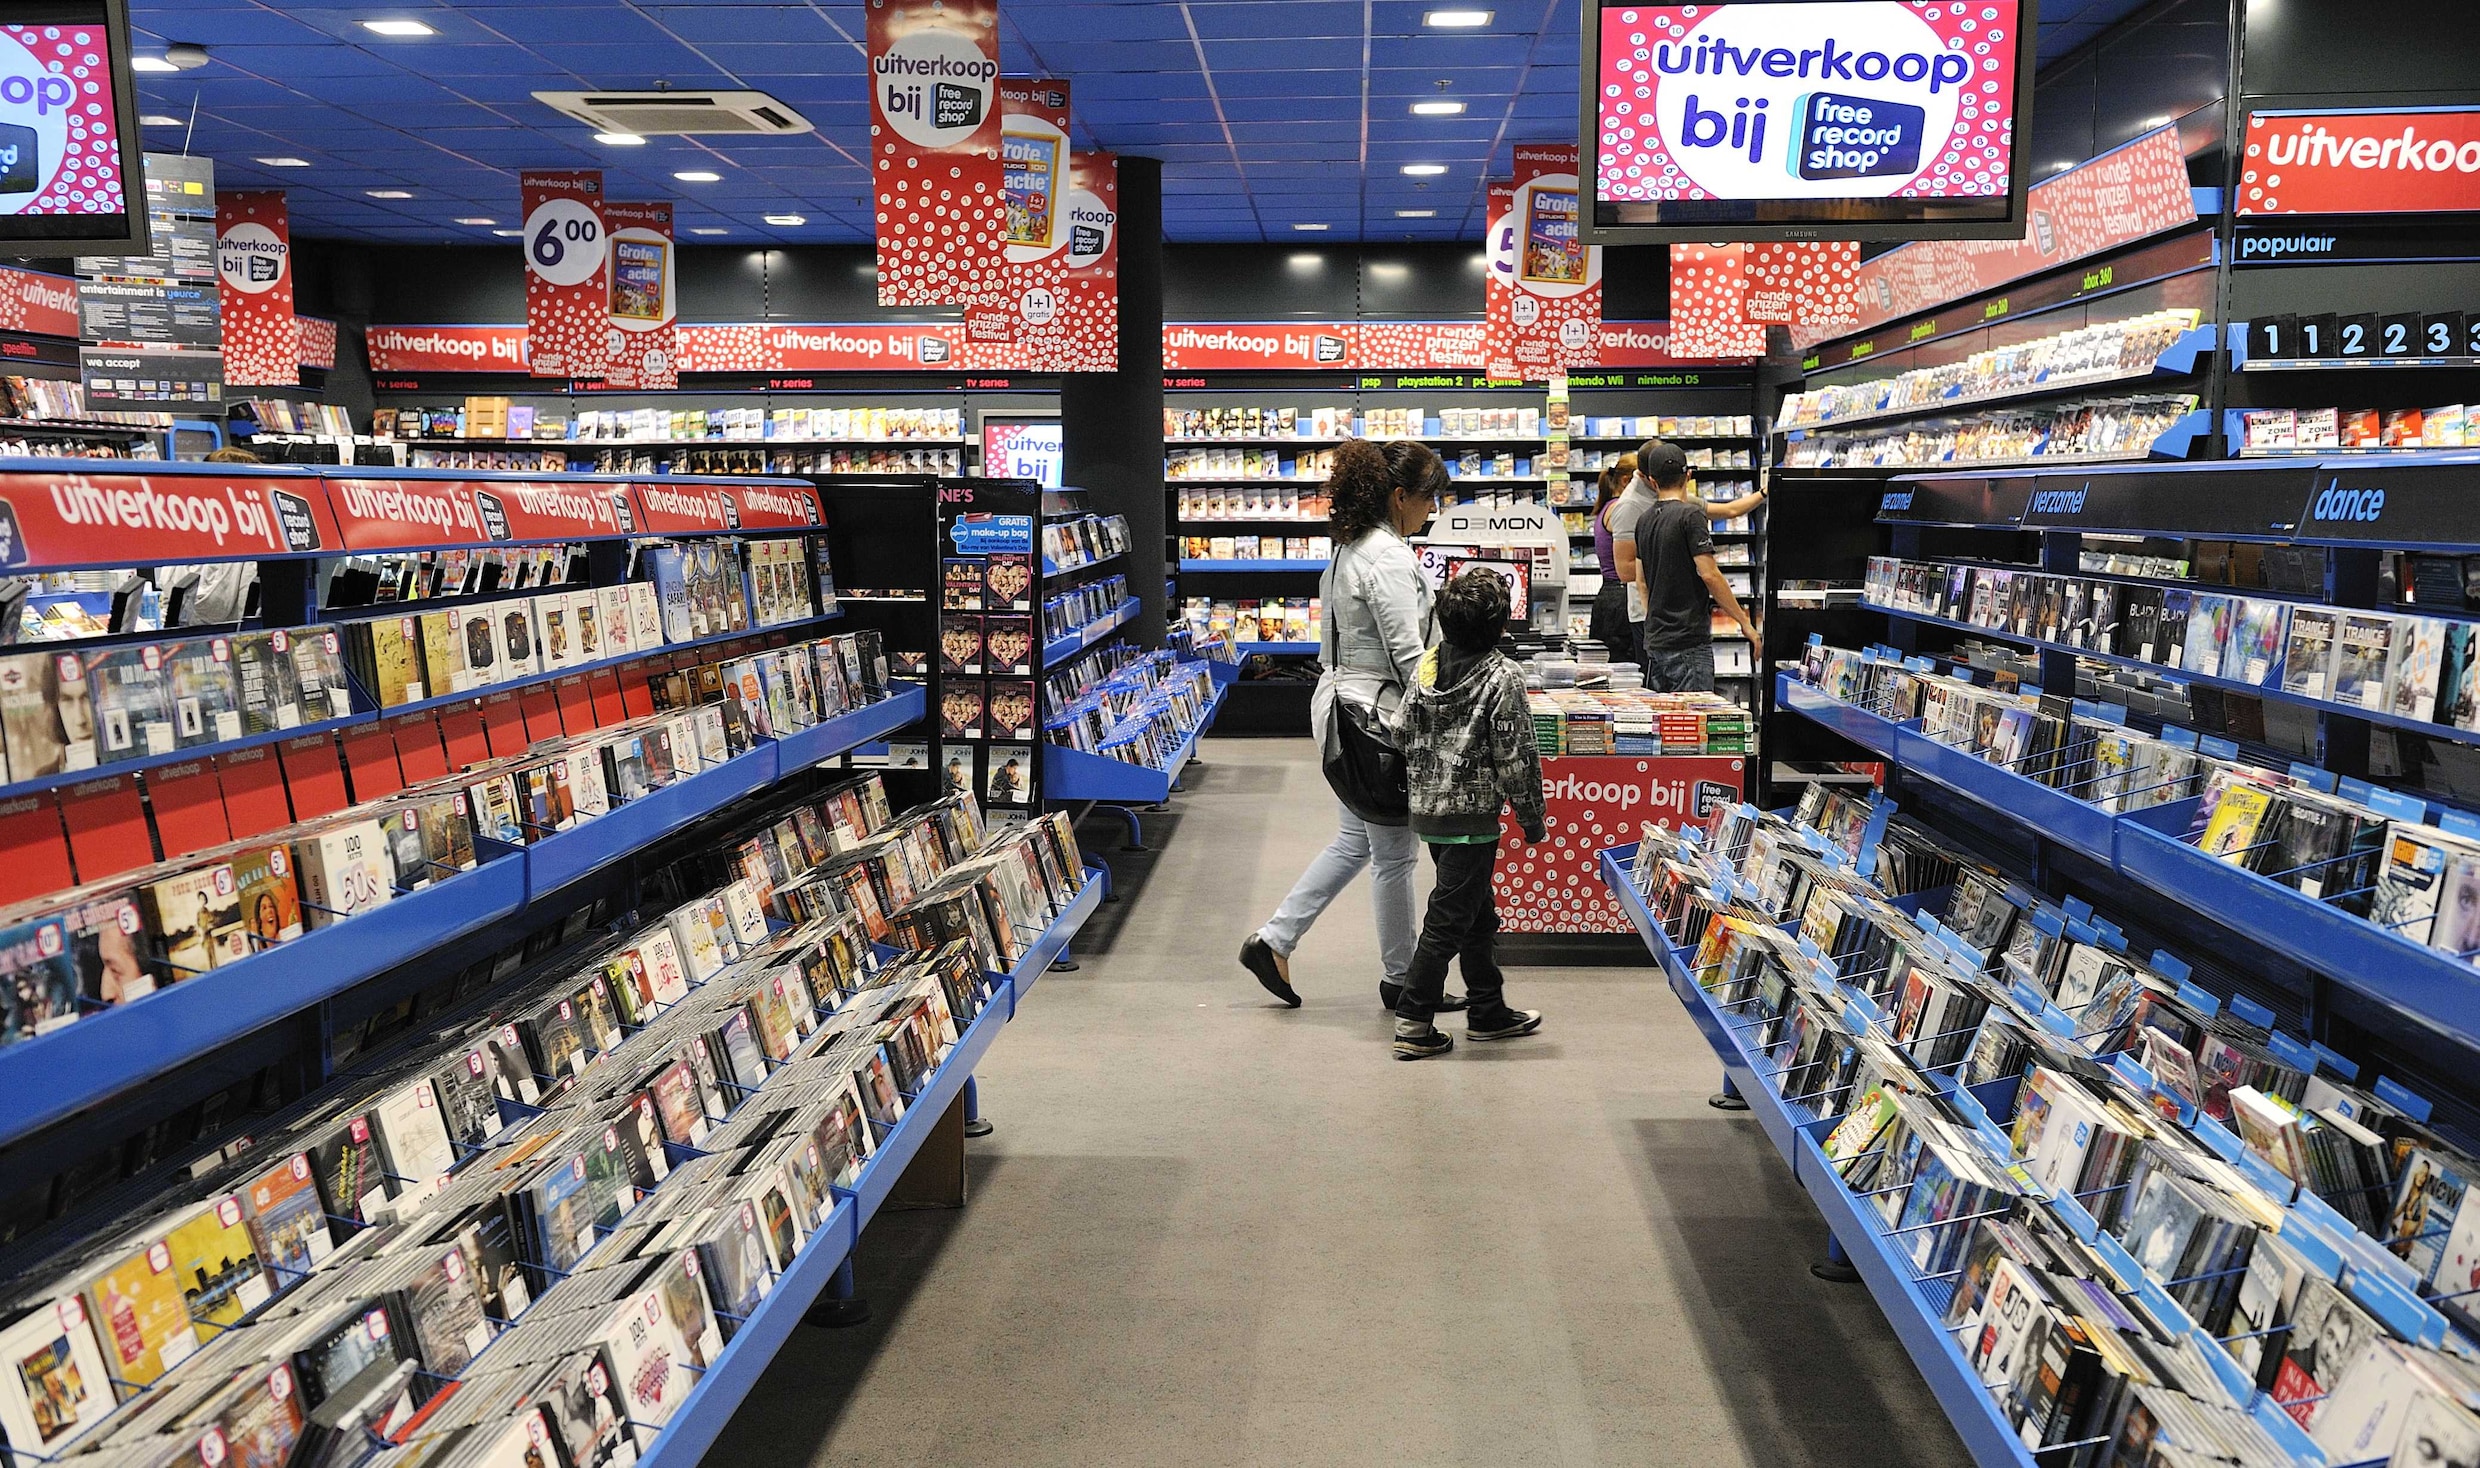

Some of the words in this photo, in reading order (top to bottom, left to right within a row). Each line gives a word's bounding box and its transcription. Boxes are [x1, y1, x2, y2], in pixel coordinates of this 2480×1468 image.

[876, 54, 996, 82] uitverkoop
[1658, 35, 1968, 93] uitverkoop
[939, 86, 961, 99] free
[888, 86, 920, 120] bij
[938, 98, 972, 111] record
[1814, 97, 1872, 125] free
[938, 110, 965, 124] shop
[1682, 95, 1769, 163] bij
[1811, 124, 1901, 147] record
[1808, 146, 1879, 173] shop
[2096, 155, 2132, 185] ronde
[524, 177, 570, 190] uitverkoop
[573, 179, 583, 191] bij
[1004, 173, 1045, 190] actie
[1030, 195, 1044, 204] 1+1
[1535, 193, 1578, 212] Grote
[2094, 184, 2132, 215] prijzen
[646, 210, 656, 221] bij
[2102, 204, 2143, 235] festival
[1075, 227, 1091, 236] free
[1545, 223, 1578, 237] actie
[216, 236, 287, 255] uitverkoop
[1075, 236, 1099, 245] record
[1075, 244, 1093, 253] shop
[2242, 232, 2336, 257] populair
[618, 243, 653, 260] Grote
[223, 258, 243, 276] bij
[252, 257, 266, 265] free
[252, 264, 274, 273] record
[252, 271, 271, 281] shop
[627, 268, 658, 281] actie
[80, 284, 154, 297] entertainment
[156, 286, 165, 297] is
[167, 290, 201, 300] yource
[1027, 295, 1050, 309] 1+1
[1746, 299, 1788, 312] prijzen
[976, 310, 1009, 323] ronde
[1027, 310, 1050, 320] gratis
[968, 319, 1004, 333] prijzen
[1437, 326, 1486, 339] ronde
[971, 328, 1009, 341] festival
[1565, 337, 1584, 345] gratis
[2264, 325, 2278, 353] 1
[2304, 325, 2318, 353] 1
[2342, 324, 2365, 354] 2
[2384, 323, 2407, 354] 2
[2427, 323, 2450, 352] 3
[378, 333, 487, 361] uitverkoop
[492, 336, 517, 362] bij
[773, 330, 882, 359] uitverkoop
[888, 333, 913, 360] bij
[1169, 329, 1280, 354] uitverkoop
[1285, 334, 1309, 359] bij
[1426, 337, 1479, 355] prijzen
[1515, 346, 1547, 356] prijzen
[1521, 340, 1550, 349] ronde
[86, 358, 99, 368] we
[101, 358, 140, 369] accept
[647, 354, 664, 363] 1+1
[1430, 348, 1485, 366] festival
[1517, 354, 1550, 364] festival
[377, 381, 389, 389] tv
[391, 381, 418, 389] series
[574, 382, 584, 390] tv
[770, 379, 781, 388] tv
[784, 379, 812, 388] series
[967, 379, 978, 388] tv
[980, 379, 1009, 388] series
[1163, 378, 1173, 387] tv
[1176, 379, 1205, 387] series
[1362, 377, 1381, 388] psp
[1397, 376, 1451, 389] playstation
[1455, 376, 1463, 387] 2
[1473, 378, 1485, 388] pc
[1608, 376, 1624, 387] Wii
[1638, 375, 1682, 386] nintendo
[1685, 375, 1700, 386] DS
[2267, 427, 2292, 435] ZONE
[2308, 426, 2333, 434] ZONE
[1017, 458, 1047, 481] bij
[744, 486, 794, 522] uitverkoop
[1881, 486, 1916, 512] verzamel
[2032, 481, 2091, 514] verzamel
[2314, 478, 2385, 522] dance
[50, 474, 228, 546] uitverkoop
[229, 483, 275, 549] bij
[342, 481, 450, 537] uitverkoop
[449, 488, 482, 540] bij
[516, 482, 594, 530] uitverkoop
[590, 489, 617, 532] bij
[644, 485, 707, 526] uitverkoop
[706, 489, 724, 528] bij
[999, 518, 1028, 526] GRATIS
[971, 529, 1010, 538] make-up
[1012, 528, 1029, 539] bag
[1423, 551, 1435, 568] 3
[2293, 618, 2329, 637] TRANCE
[2345, 625, 2386, 644] TRANCE
[579, 756, 591, 770] 100
[159, 763, 200, 780] uitverkoop
[74, 777, 120, 797] uitverkoop
[1651, 778, 1686, 814] bij
[1007, 813, 1026, 821] JOHN
[345, 834, 361, 852] 100
[2213, 1051, 2238, 1079] NOW
[2285, 1367, 2302, 1391] NA
